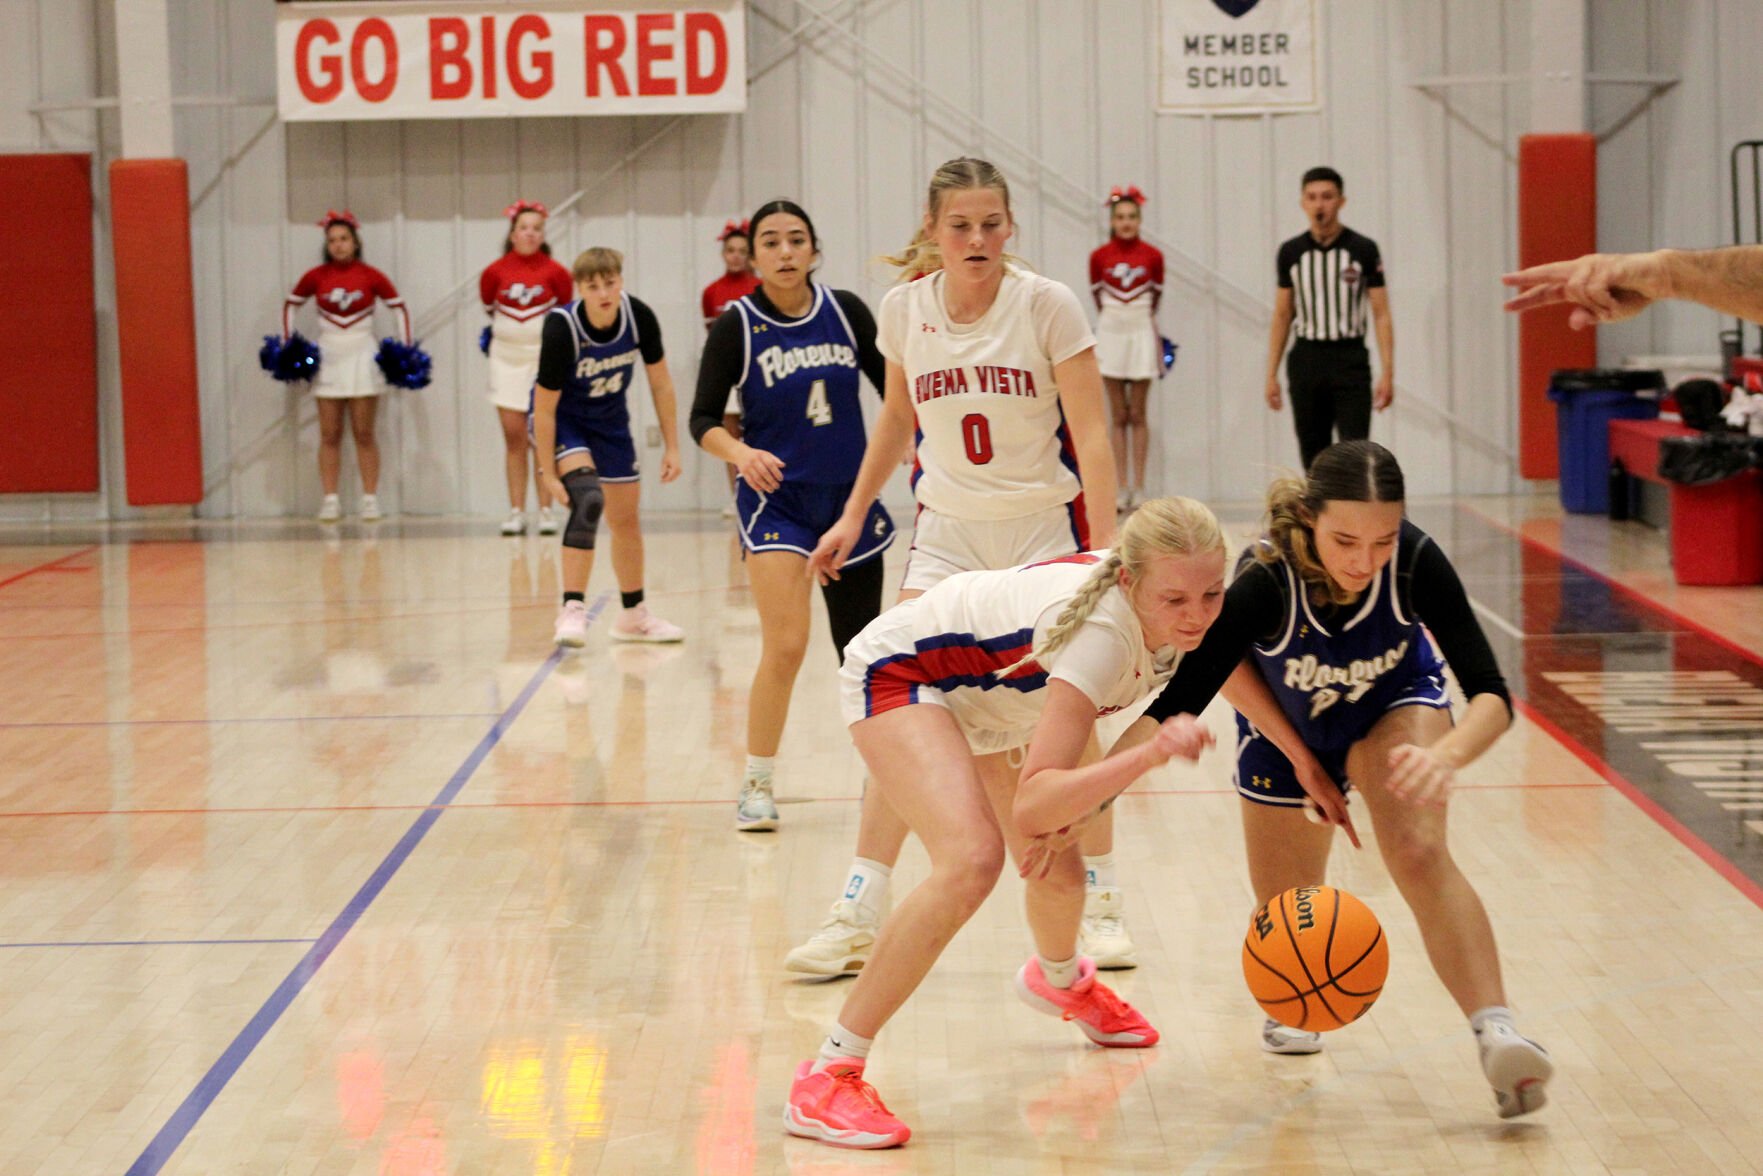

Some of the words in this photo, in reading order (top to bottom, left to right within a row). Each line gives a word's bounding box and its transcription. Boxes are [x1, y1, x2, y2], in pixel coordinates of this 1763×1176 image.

[294, 17, 399, 104] GO
[428, 14, 554, 101] BIG
[584, 12, 729, 98] RED
[1183, 33, 1289, 56] MEMBER
[1186, 65, 1289, 89] SCHOOL
[756, 342, 857, 388] Florence
[974, 365, 1037, 398] VISTA
[806, 378, 832, 427] 4
[961, 412, 994, 466] 0
[1294, 886, 1321, 932] lson
